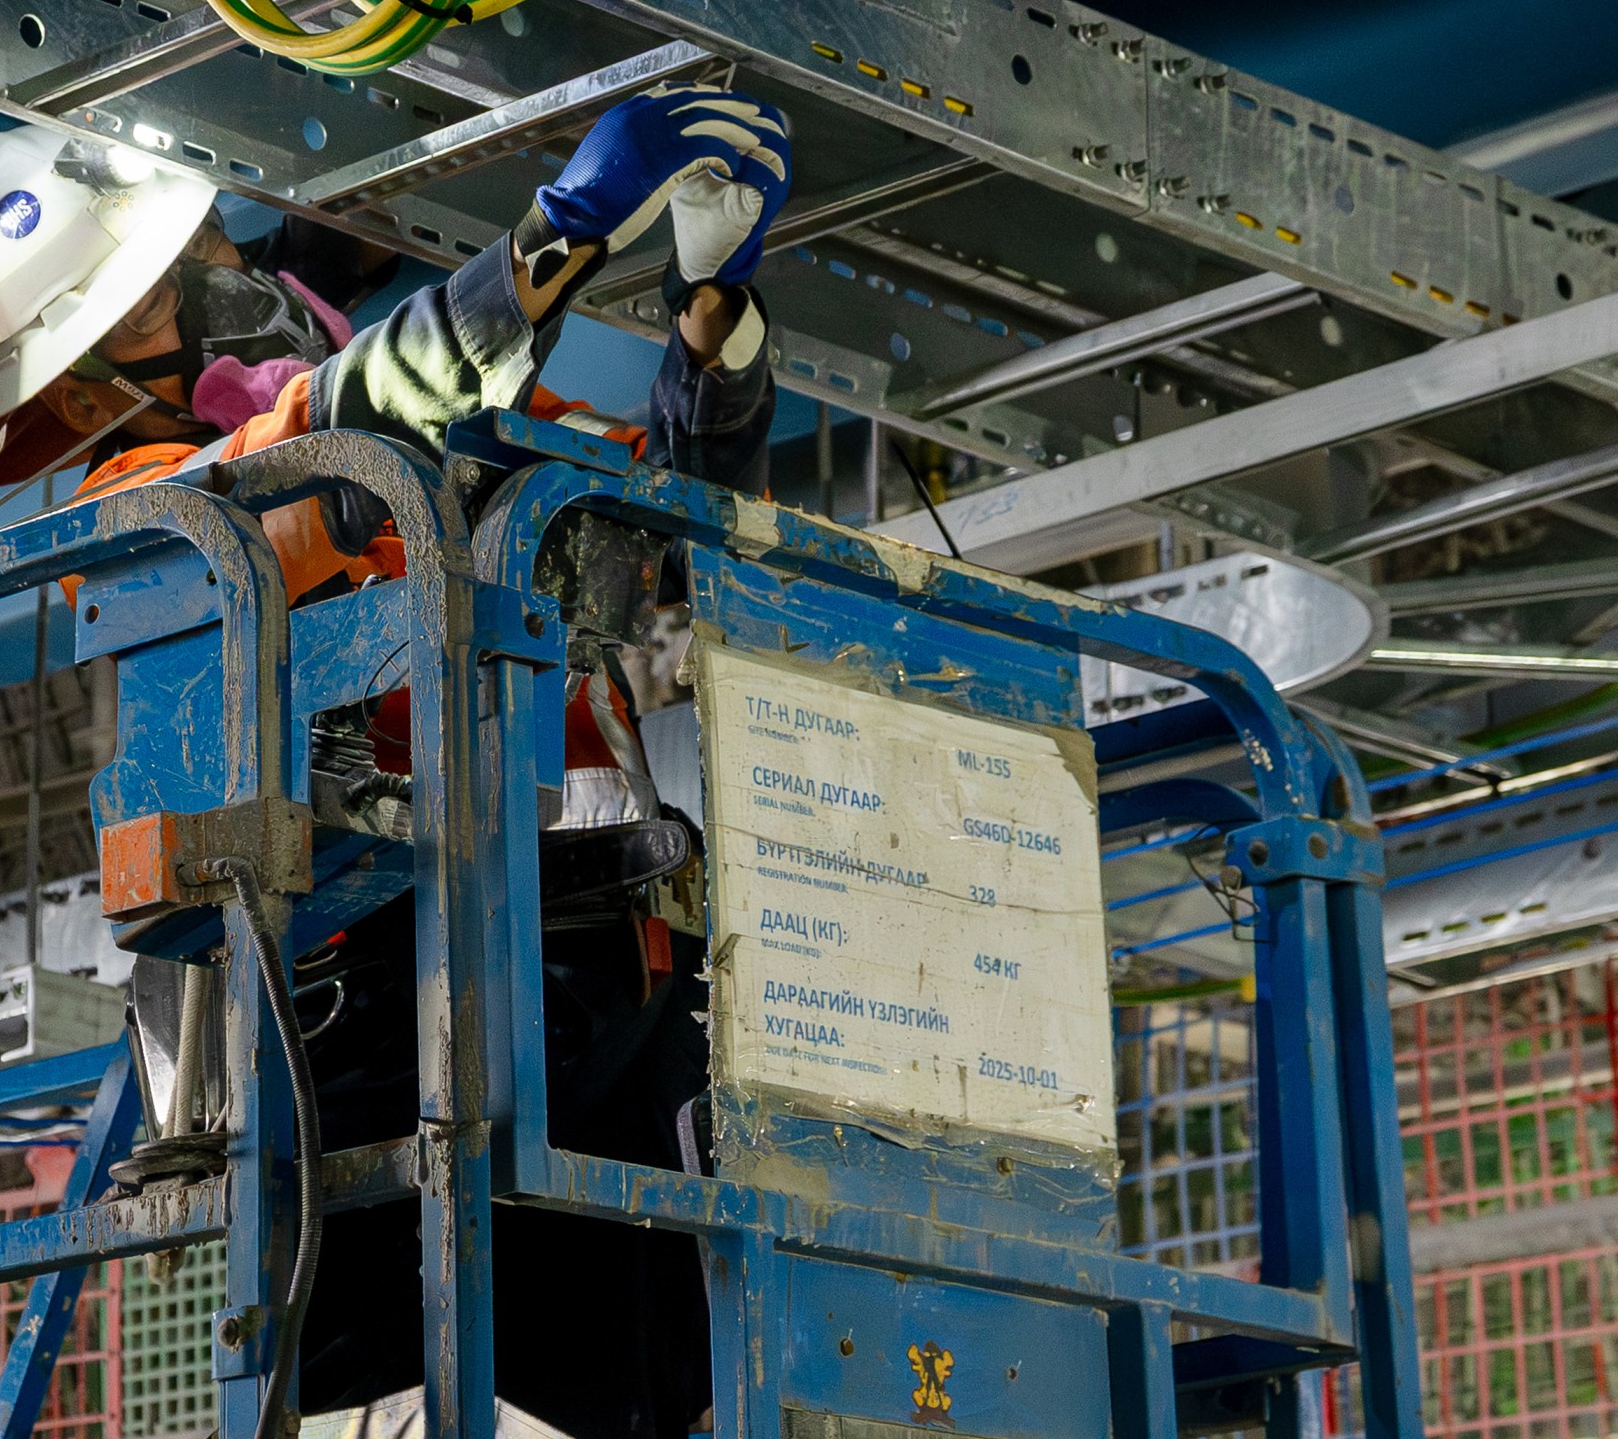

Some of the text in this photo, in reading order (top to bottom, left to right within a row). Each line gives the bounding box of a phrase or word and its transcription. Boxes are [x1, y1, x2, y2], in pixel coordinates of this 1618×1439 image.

[794, 708, 861, 741] ДУГААР:
[958, 749, 1012, 779] ML-155
[753, 766, 816, 797] СЕРИАЛ
[963, 817, 1062, 856] GS46D-12646
[761, 908, 849, 947] ДААЦ (КГ):
[764, 980, 865, 1018] ДАРААГИЙН
[765, 1014, 846, 1048] ХУГАЦАА:
[978, 1056, 1059, 1090] 2025-10-01
